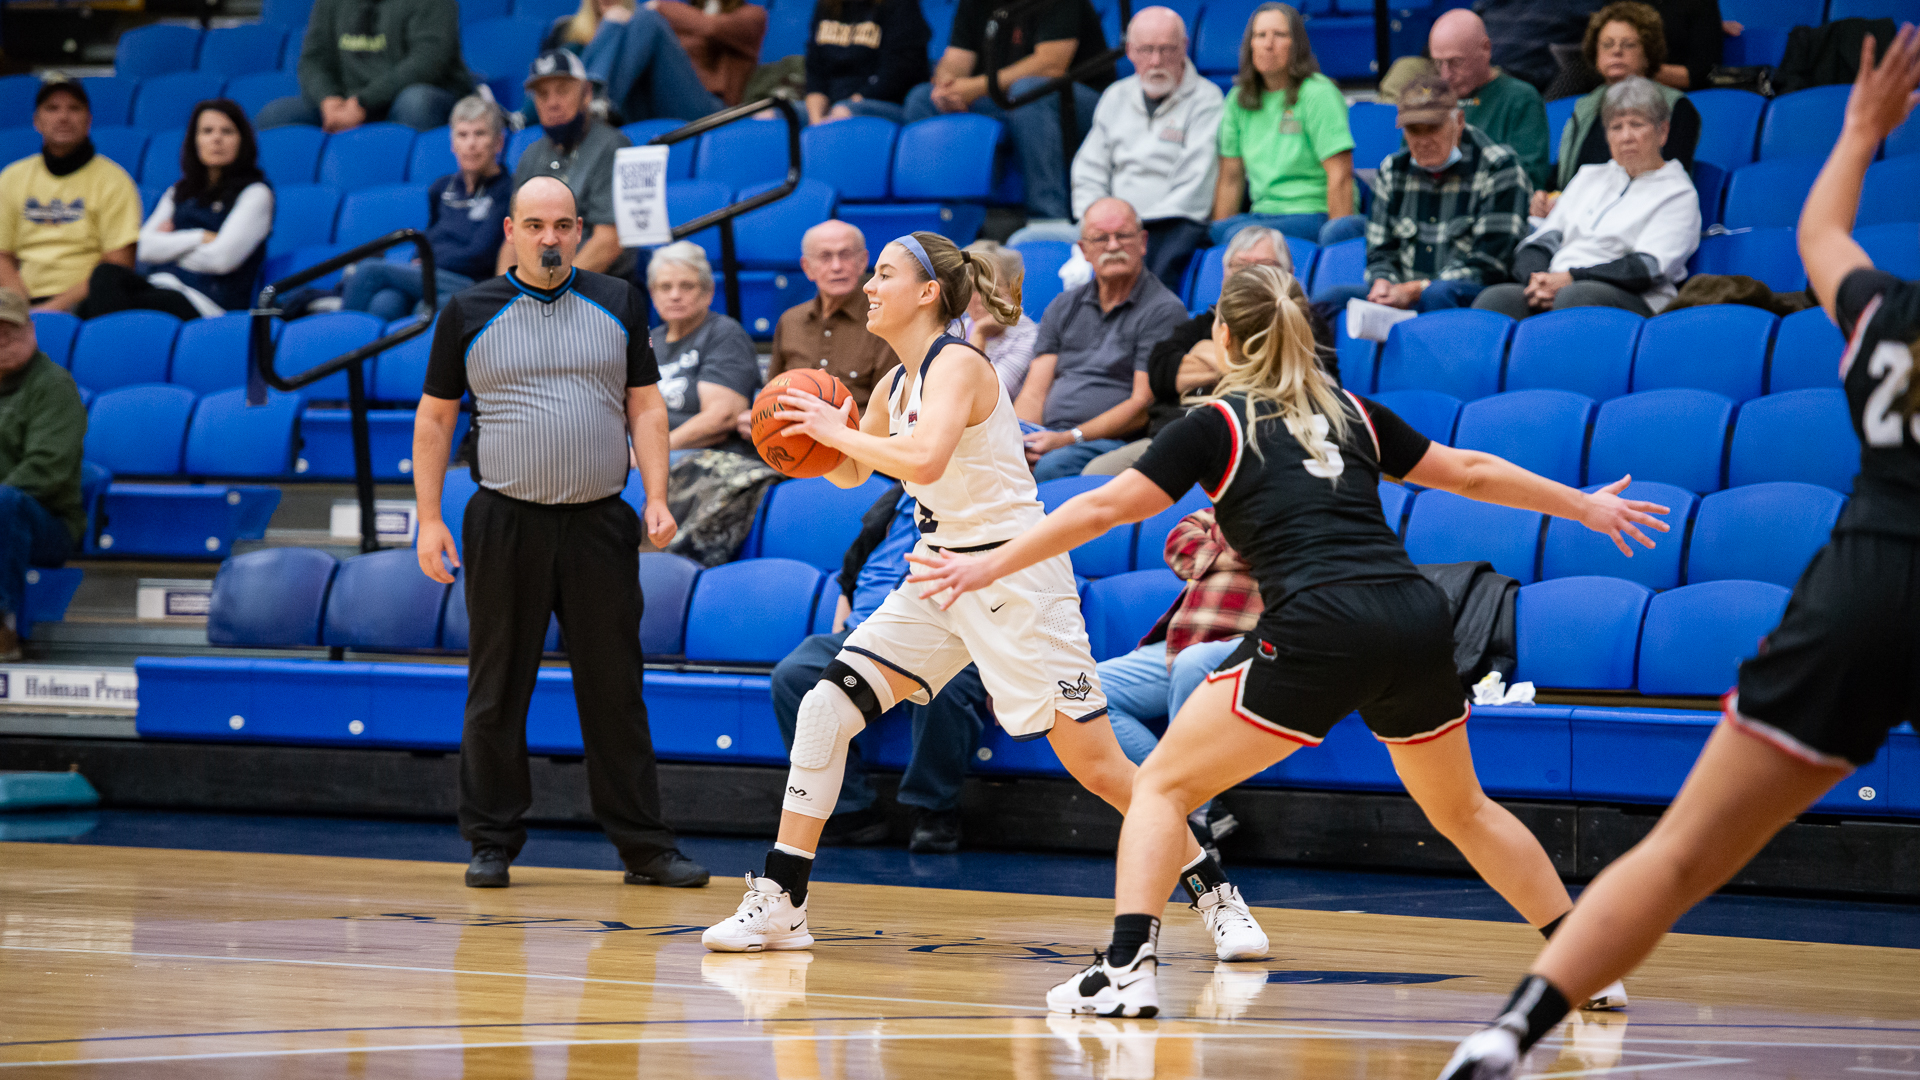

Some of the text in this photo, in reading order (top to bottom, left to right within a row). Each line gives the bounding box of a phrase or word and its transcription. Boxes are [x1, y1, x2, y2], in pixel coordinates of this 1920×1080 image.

[1862, 340, 1919, 447] 2
[25, 677, 90, 698] Holman
[1862, 789, 1873, 798] 33
